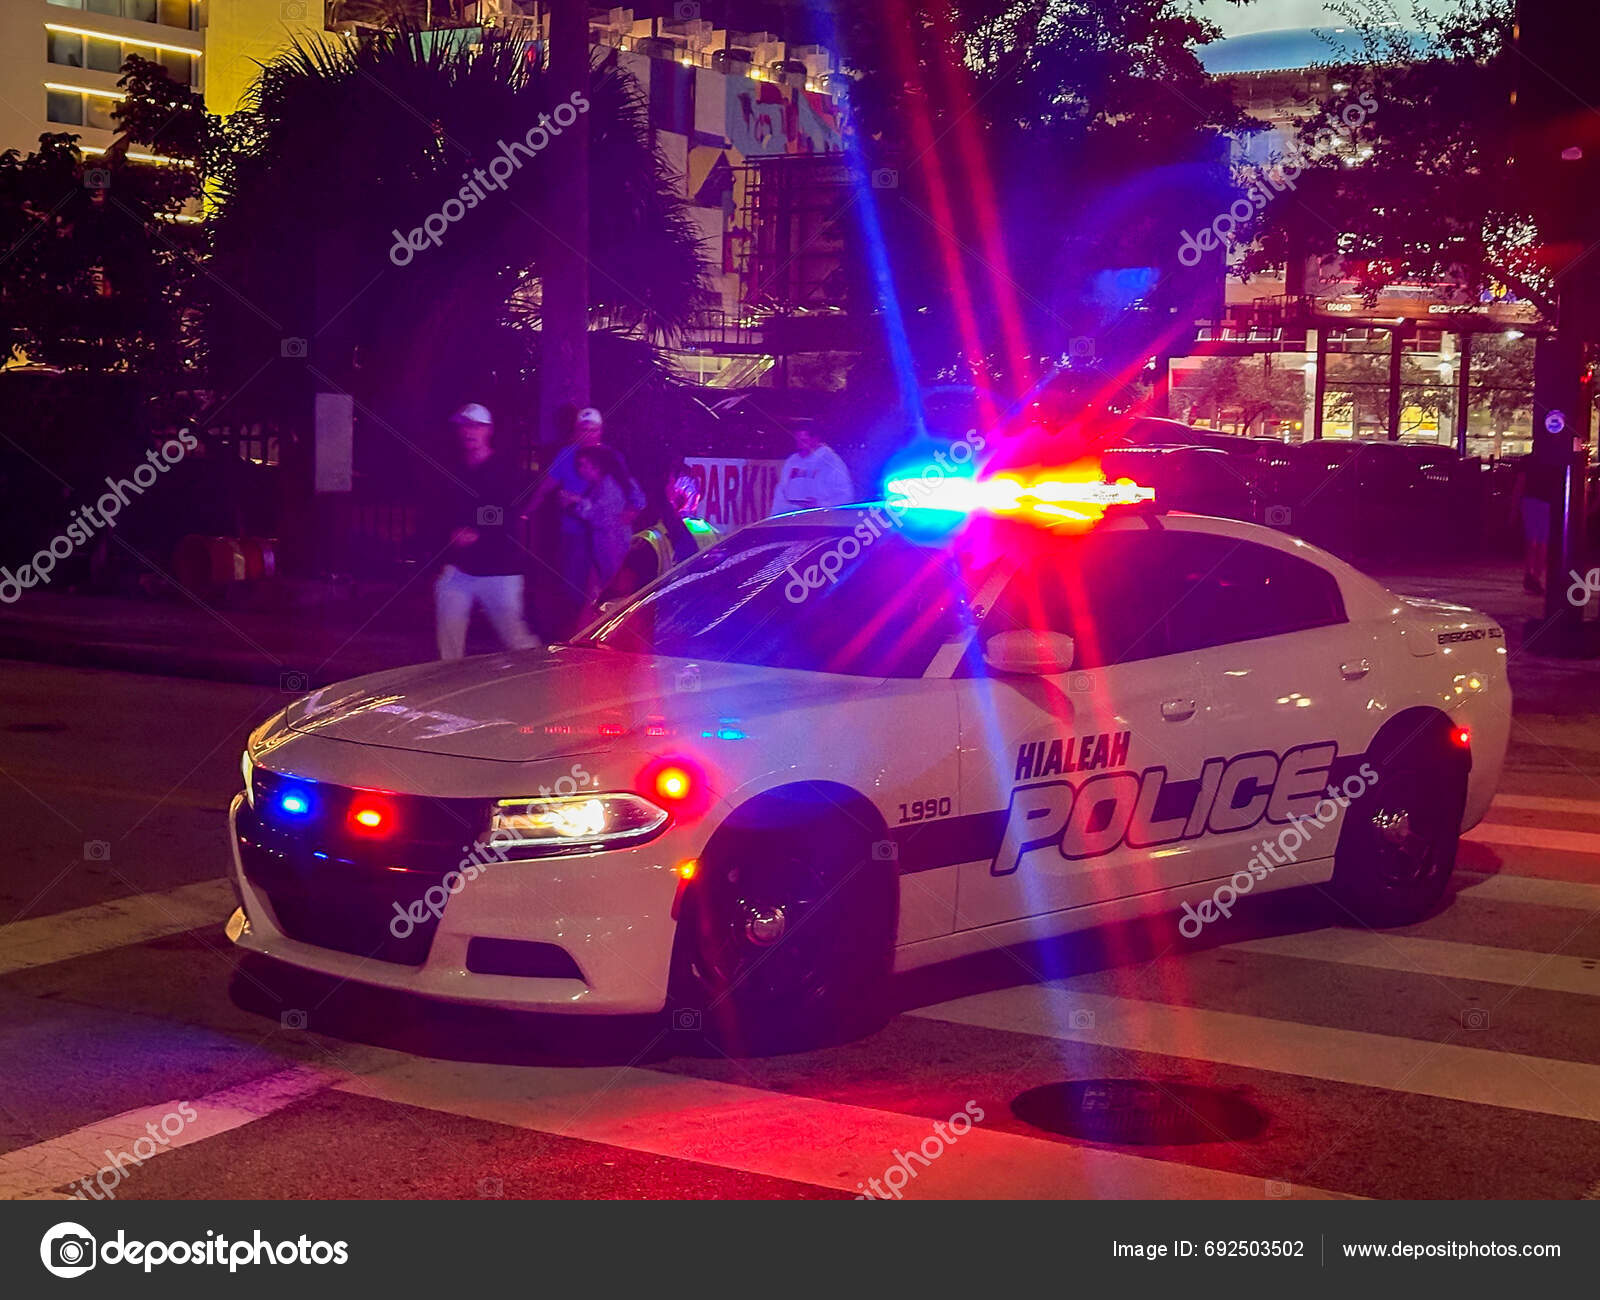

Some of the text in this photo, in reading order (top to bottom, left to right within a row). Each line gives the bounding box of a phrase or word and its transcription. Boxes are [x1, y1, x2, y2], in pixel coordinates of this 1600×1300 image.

[1015, 731, 1131, 781] HIALEAH
[898, 797, 952, 824] 1990
[990, 740, 1338, 877] POLICE
